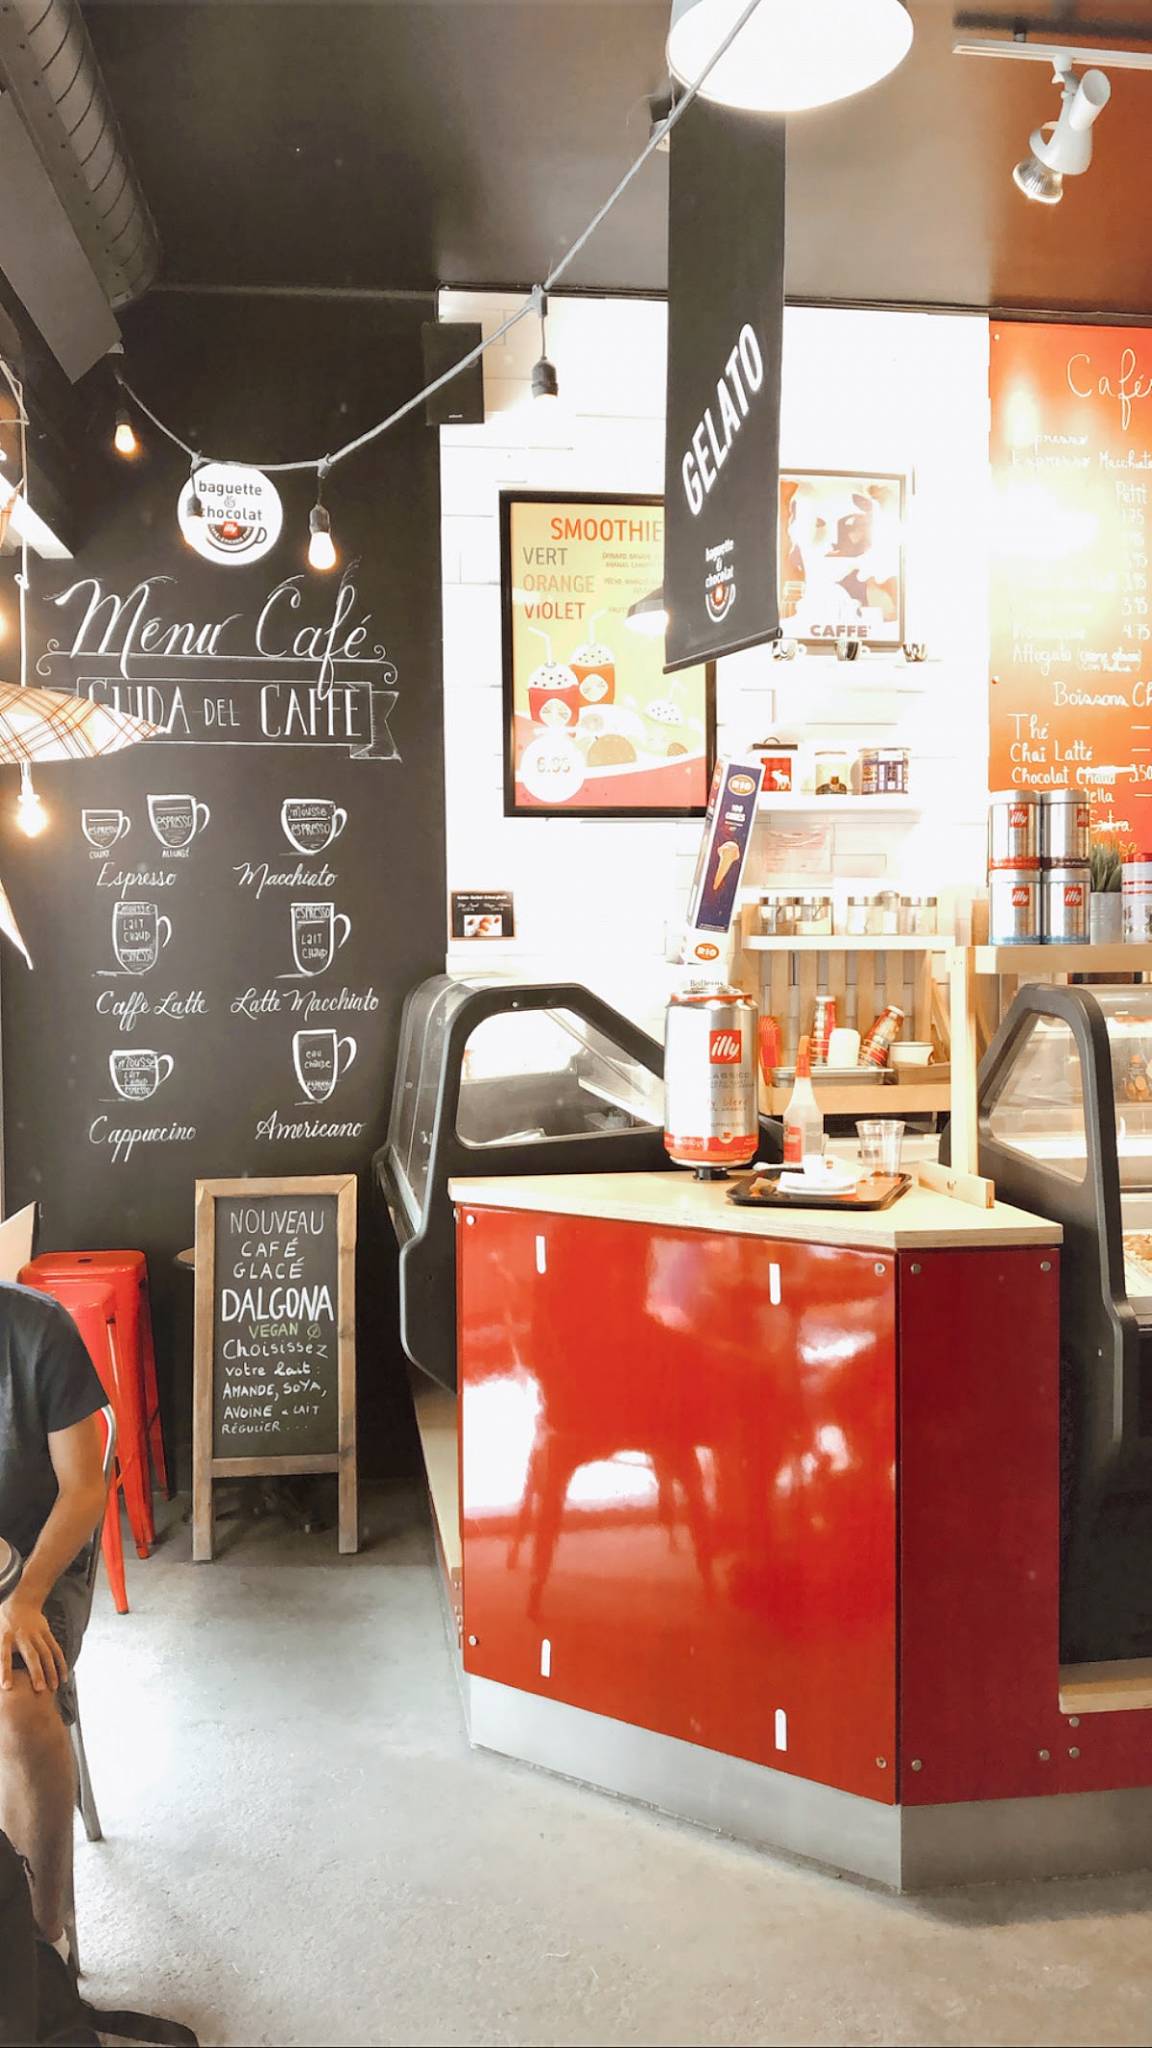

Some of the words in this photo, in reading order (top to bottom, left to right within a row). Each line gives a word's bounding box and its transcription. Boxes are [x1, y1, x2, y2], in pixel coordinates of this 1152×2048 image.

[1066, 348, 1152, 431] Café
[682, 322, 764, 517] GELATO
[199, 480, 262, 497] baguette
[203, 505, 262, 521] hocolat
[522, 547, 568, 566] VERT
[523, 574, 595, 593] ORANGE
[524, 601, 586, 620] VIOLET
[255, 560, 373, 701] Café
[204, 698, 241, 727] DEL
[1007, 713, 1049, 740] Thé
[1010, 742, 1047, 763] Chai
[1011, 766, 1069, 784] Chocolat
[96, 861, 178, 899] Espresso
[232, 862, 339, 900] Macchiato
[154, 990, 209, 1019] Latte
[230, 987, 282, 1020] Latte
[282, 987, 380, 1021] Macchiato
[711, 1035, 741, 1061] illy
[88, 1115, 197, 1163] Cappuccino
[255, 1110, 368, 1141] Americano
[230, 1208, 325, 1236] NOUVEAU
[240, 1236, 300, 1258] CAFÉ
[233, 1256, 306, 1280] GLACÉ
[221, 1284, 335, 1324] DALGONA
[249, 1323, 299, 1339] VEGAN
[222, 1338, 329, 1360] Choisissez
[225, 1361, 267, 1377] votre
